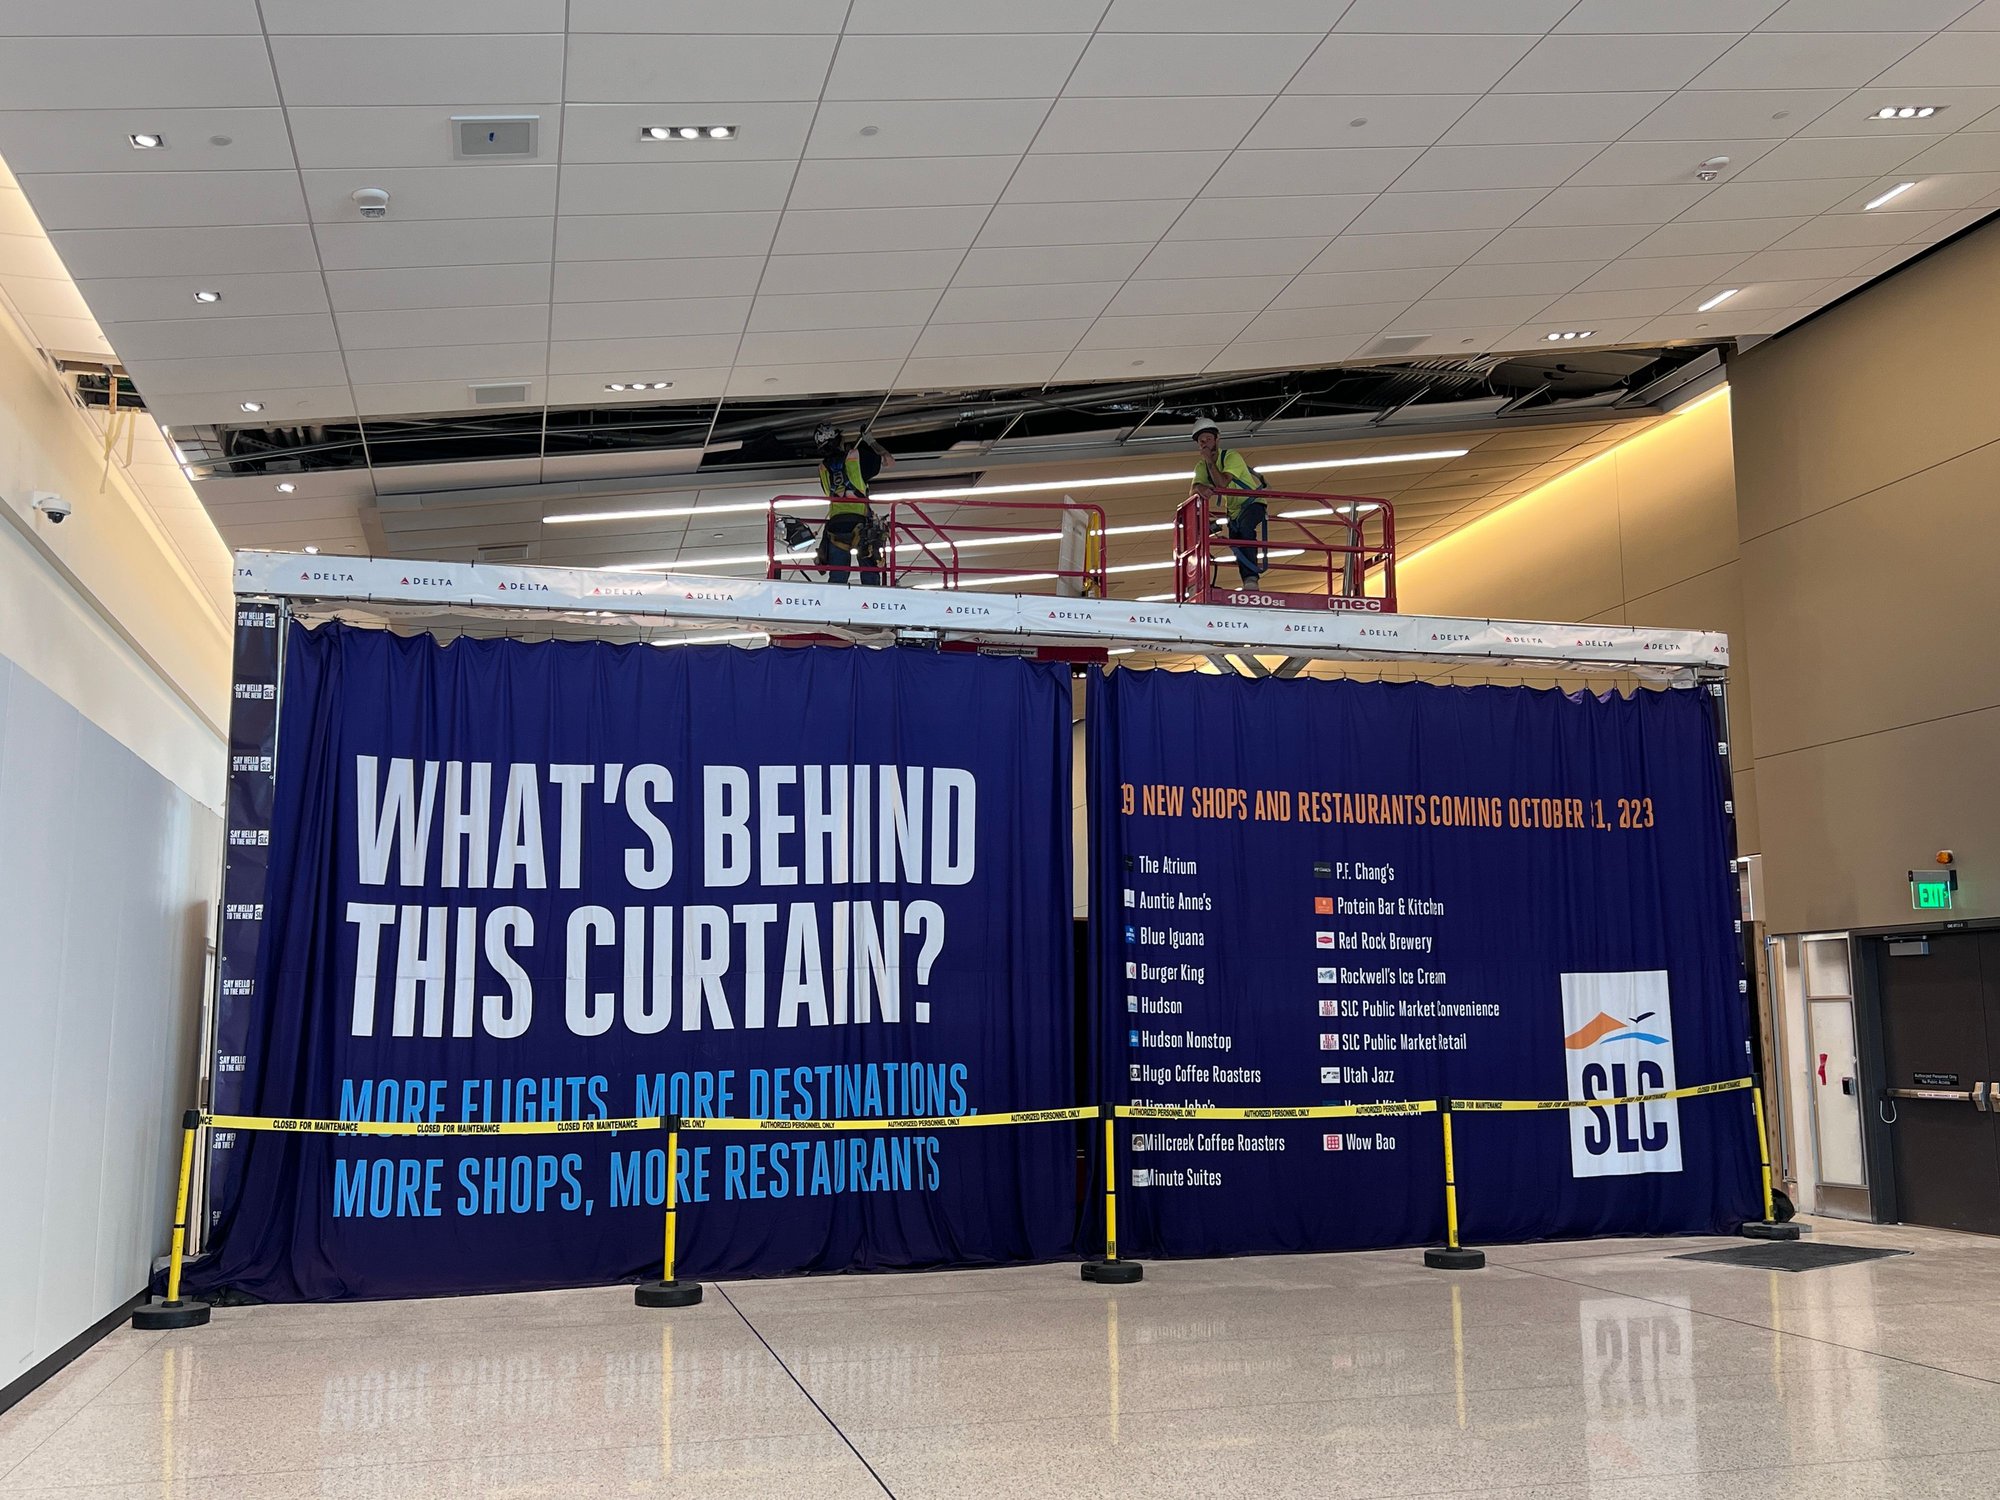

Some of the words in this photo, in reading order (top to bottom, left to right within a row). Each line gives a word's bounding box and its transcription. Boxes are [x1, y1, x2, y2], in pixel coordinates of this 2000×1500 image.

[314, 572, 354, 582] DELTA
[413, 577, 453, 587] DELTA
[510, 582, 549, 592] DELTA
[605, 588, 643, 596] DELTA
[697, 592, 734, 601] DELTA
[786, 598, 821, 606] DELTA
[872, 602, 907, 611] DELTA
[956, 607, 990, 615] DELTA
[1329, 599, 1380, 611] mec
[1058, 611, 1092, 620] DELTA
[1139, 616, 1171, 624] DELTA
[1217, 621, 1249, 629] DELTA
[1368, 629, 1398, 638] DELTA
[1513, 636, 1543, 644] DELTA
[1584, 640, 1614, 648] DELTA
[233, 756, 243, 764] SAY
[1143, 785, 1184, 816] NEW
[1191, 787, 1247, 820] SHOPS
[1255, 790, 1290, 821] AND
[1298, 792, 1426, 825] RESTAURANTS
[1430, 795, 1502, 828] COMING
[1509, 798, 1584, 828] OCTOBER
[356, 754, 674, 889] WHAT'S
[703, 764, 976, 887] BEHIND
[230, 830, 240, 838] SAY
[241, 830, 256, 838] HELLO
[1139, 856, 1159, 874] The
[1162, 856, 1197, 874] Atrium
[1336, 862, 1352, 880] P.F.
[1355, 862, 1394, 884] Chang's
[1140, 891, 1175, 909] Auntie
[1178, 892, 1212, 910] Anne's
[1337, 897, 1375, 914] Protein
[1378, 898, 1394, 915] Bar
[1398, 898, 1405, 915] &
[226, 904, 237, 912] SAY
[238, 904, 253, 912] HELLO
[1140, 927, 1165, 945] Blue
[1169, 927, 1204, 949] Iguana
[1339, 932, 1357, 949] Red
[1361, 932, 1386, 949] Rock
[1390, 932, 1432, 953] Brewery
[346, 902, 535, 1038] THIS
[565, 900, 946, 1036] CURTAIN?
[1141, 964, 1178, 983] Burger
[1180, 964, 1204, 984] King
[1340, 968, 1396, 984] Rockwell's
[1399, 968, 1414, 984] Ice
[1417, 968, 1446, 984] Cream
[223, 980, 234, 988] SAY
[235, 980, 250, 988] HELLO
[1142, 997, 1182, 1014] Hudson
[1341, 1000, 1358, 1016] SLC
[1363, 1000, 1395, 1016] Public
[1399, 1000, 1435, 1016] Market
[1437, 1000, 1500, 1016] Convenience
[1142, 1030, 1182, 1048] Hudson
[1186, 1031, 1232, 1052] Nonstop
[1342, 1034, 1360, 1050] SLC
[1364, 1034, 1396, 1050] Public
[1400, 1034, 1437, 1050] Market
[1439, 1033, 1467, 1050] Retail
[1143, 1065, 1171, 1085] Hugo
[1175, 1064, 1209, 1082] Coffee
[1212, 1066, 1261, 1083] Roasters
[1343, 1067, 1368, 1083] Utah
[1372, 1066, 1394, 1083] Jazz
[337, 1078, 448, 1137] MORE
[636, 1070, 734, 1122] MORE
[750, 1062, 979, 1119] DESTINATIONS,
[1128, 1108, 1157, 1116] AUTHORIZED
[1158, 1109, 1183, 1117] PERSONNEL
[1272, 1109, 1297, 1117] PERSONNEL
[1298, 1109, 1310, 1117] ONLY
[1356, 1104, 1382, 1114] AUTHORIZED
[1383, 1104, 1408, 1113] PERSONNEL
[1408, 1103, 1419, 1111] ONLY
[1582, 1061, 1668, 1156] SLC
[1011, 1113, 1039, 1122] AUTHORIZED
[1040, 1111, 1067, 1120] PERSONNEL
[1068, 1110, 1080, 1118] ONLY
[273, 1120, 297, 1129] CLOSED
[300, 1121, 312, 1130] FOR
[314, 1122, 358, 1132] MAINTENANCE
[417, 1124, 440, 1133] CLOSED
[443, 1124, 455, 1132] FOR
[457, 1124, 500, 1133] MAINTENANCE
[558, 1122, 580, 1131] CLOSED
[582, 1122, 594, 1130] FOR
[597, 1120, 637, 1130] MAINTENANCE
[693, 1120, 705, 1128] ONLY
[918, 1119, 946, 1127] PERSONNEL
[1144, 1134, 1194, 1151] Millcreek
[1197, 1134, 1234, 1151] Coffee
[1238, 1134, 1285, 1151] Roasters
[1346, 1134, 1372, 1150] Wow
[1376, 1134, 1395, 1150] Bao
[332, 1158, 443, 1218] MORE
[458, 1154, 594, 1217] SHOPS,
[609, 1145, 710, 1208] MORE
[1148, 1169, 1183, 1186] Minute
[1187, 1168, 1221, 1186] Suites
